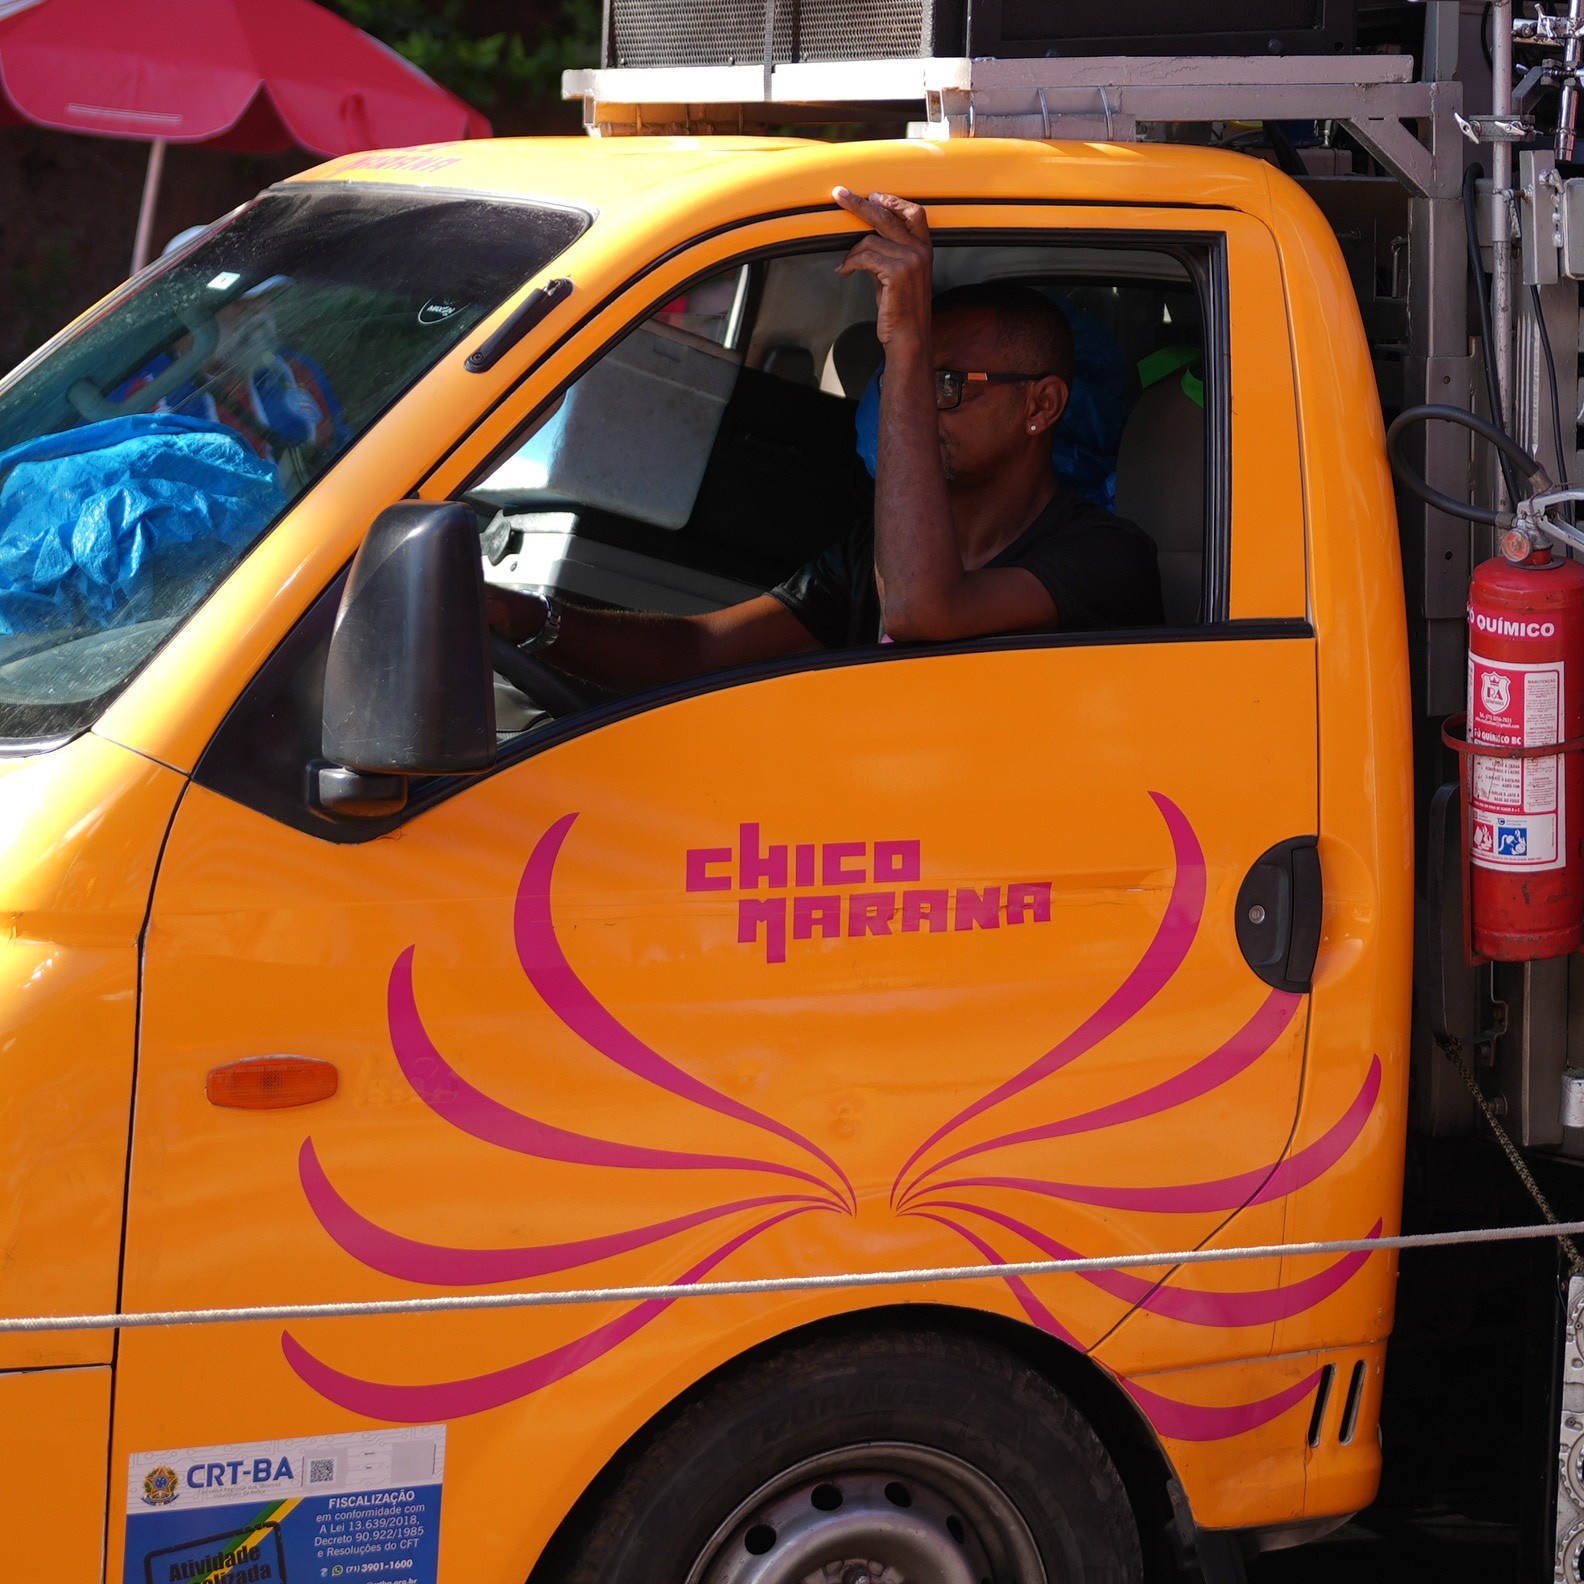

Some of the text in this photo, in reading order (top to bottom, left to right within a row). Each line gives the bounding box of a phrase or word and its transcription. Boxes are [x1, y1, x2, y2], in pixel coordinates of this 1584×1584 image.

[1476, 614, 1555, 638] QUÍMICO
[1511, 736, 1522, 745] BC
[686, 822, 921, 893] CHICO
[736, 881, 1053, 965] MARANA
[186, 1456, 294, 1489] CRT-BA
[328, 1488, 415, 1510] FISCALIZAÇÃO
[316, 1504, 425, 1523] em conformidade com
[319, 1515, 420, 1534] A Lei 13.639/2018,
[315, 1526, 424, 1547] Decreto 90.922/1985
[317, 1538, 419, 1558] e Resoluções do CFT
[169, 1543, 262, 1584] Atividade
[345, 1559, 413, 1575] (71) 3901-1600
